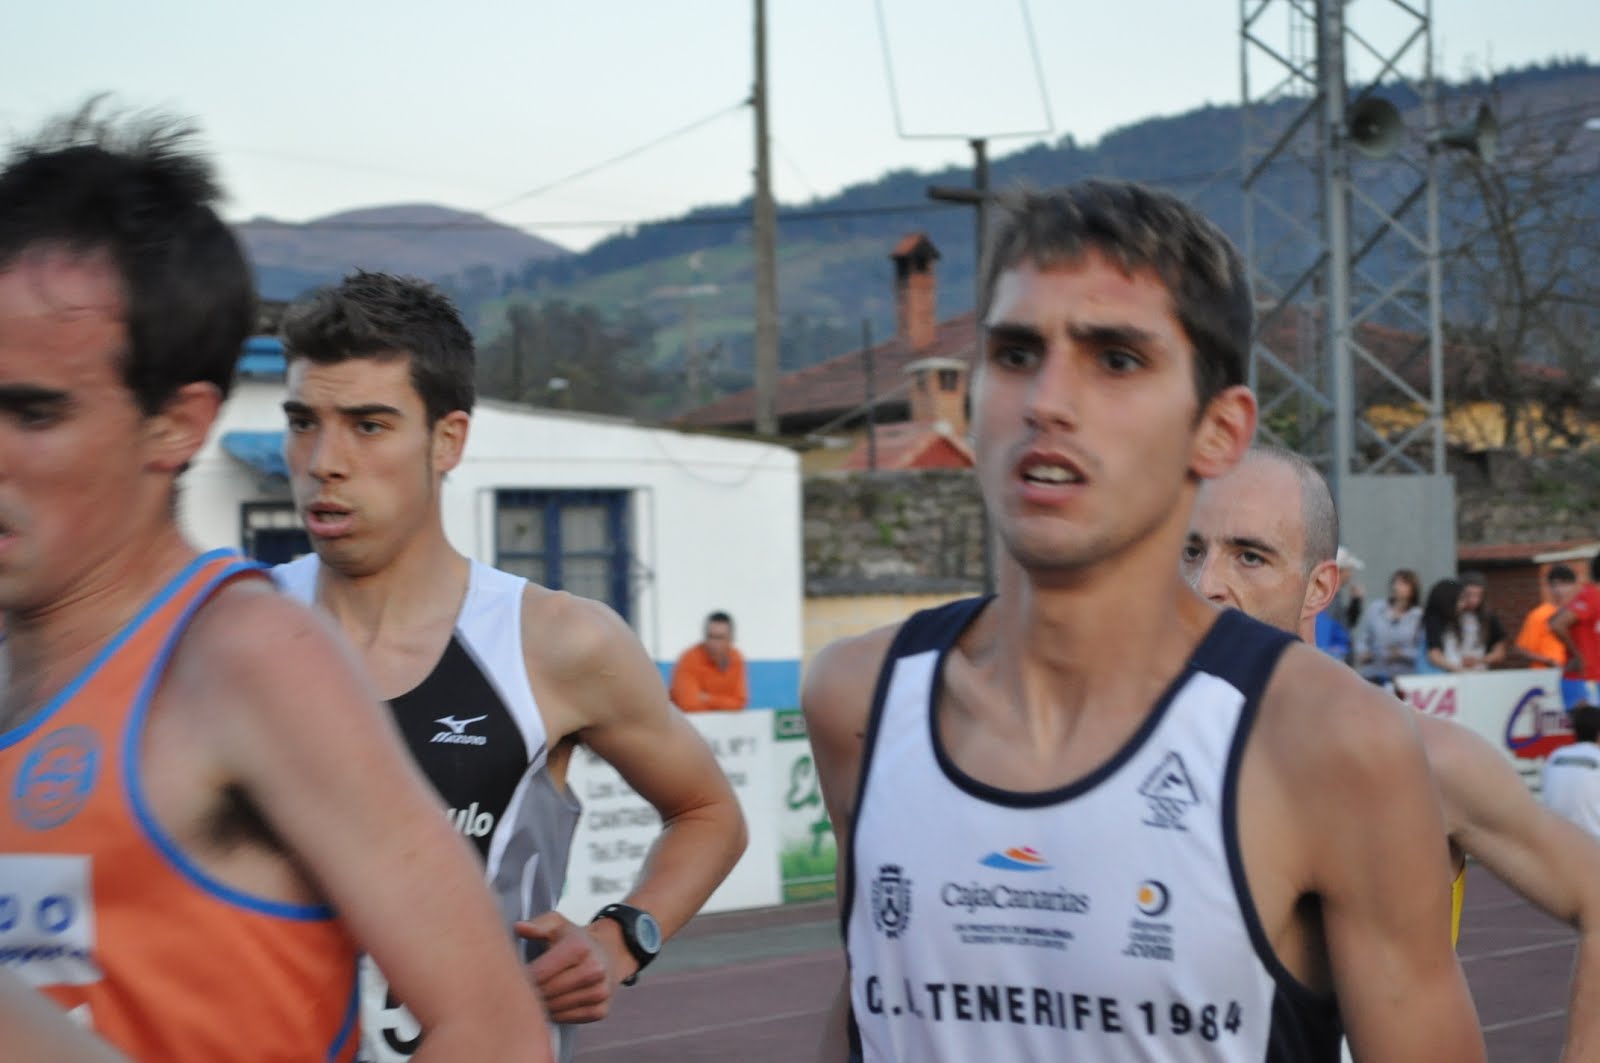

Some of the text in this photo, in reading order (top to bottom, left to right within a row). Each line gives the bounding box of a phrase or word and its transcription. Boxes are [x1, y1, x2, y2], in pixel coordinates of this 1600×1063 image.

[941, 880, 1091, 914] CajaCanarias
[925, 983, 1123, 1034] TENERIFE
[1137, 1000, 1243, 1042] 1984
